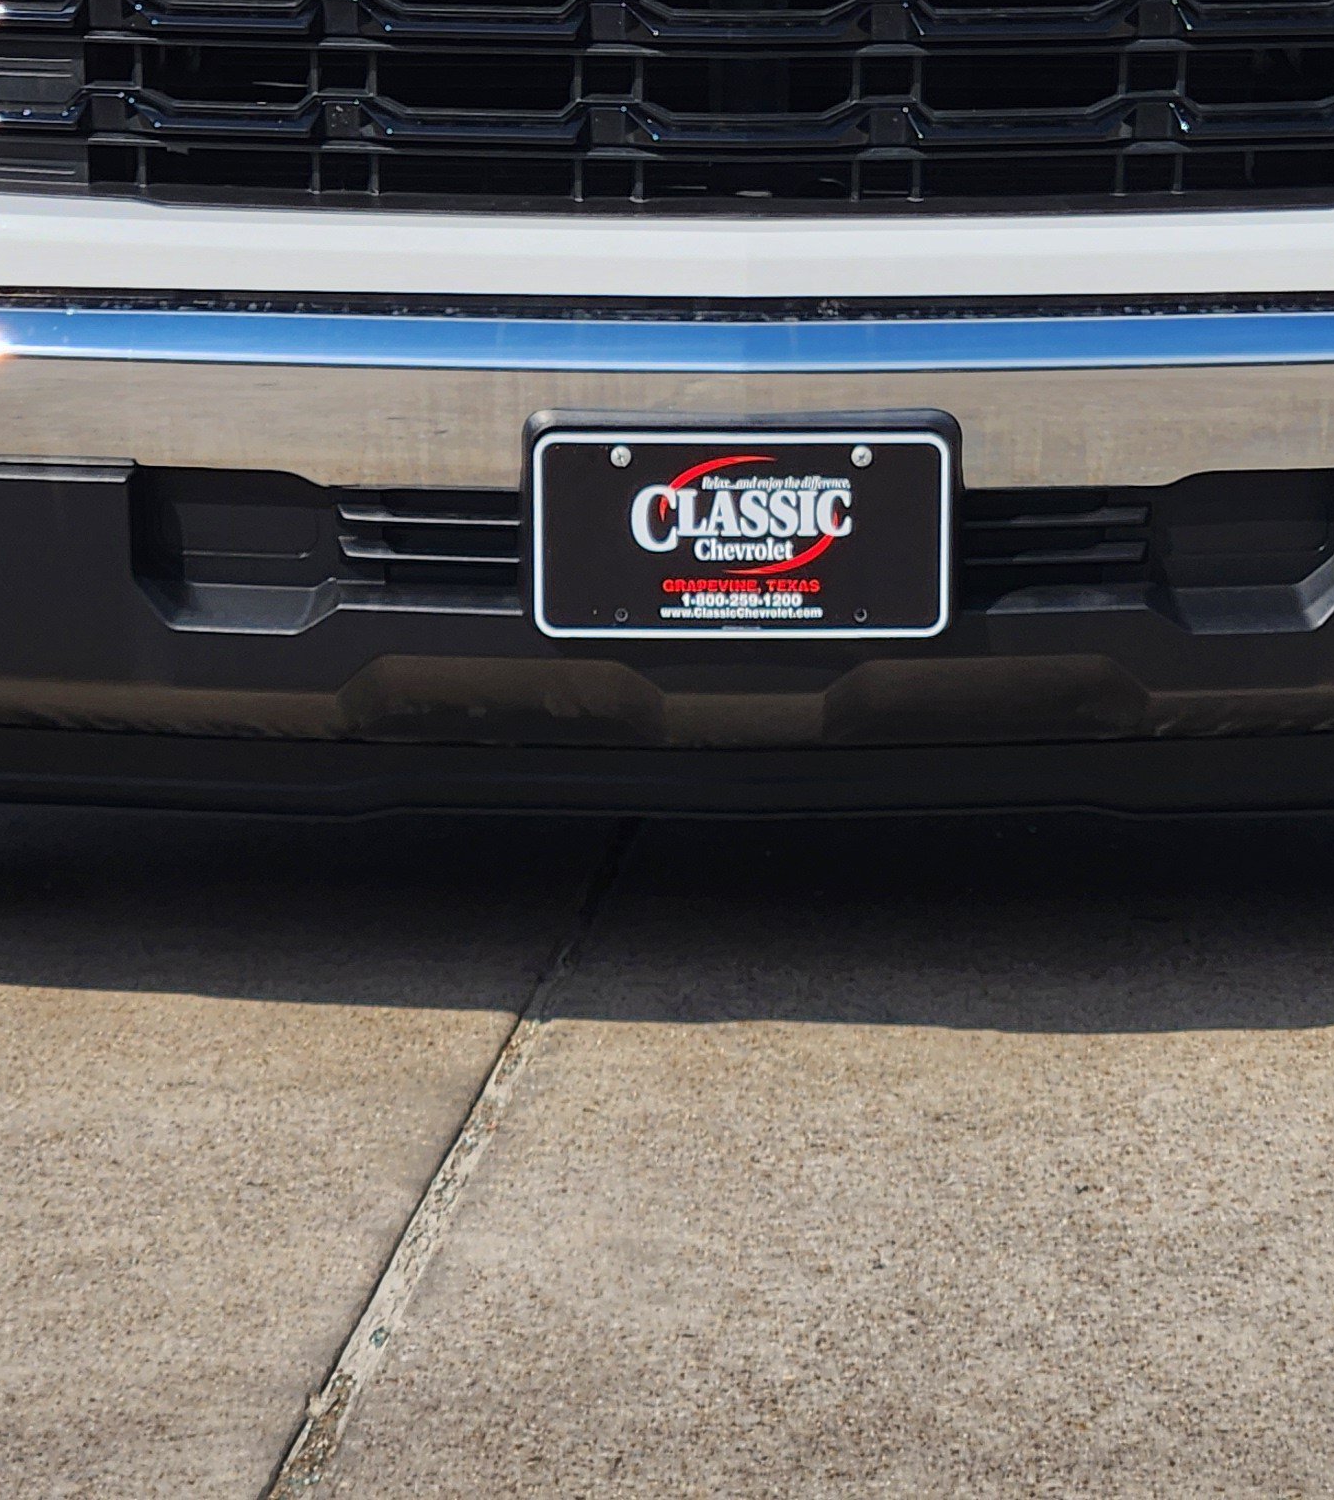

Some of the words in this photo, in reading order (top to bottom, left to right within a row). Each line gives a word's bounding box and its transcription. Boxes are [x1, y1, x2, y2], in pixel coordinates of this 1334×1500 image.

[756, 478, 784, 492] enjoy
[784, 475, 801, 489] the
[631, 484, 852, 552] CLASSIC
[694, 538, 794, 561] Chevrolet
[662, 578, 762, 594] GRAPEVINE,
[766, 579, 821, 593] TEXAS
